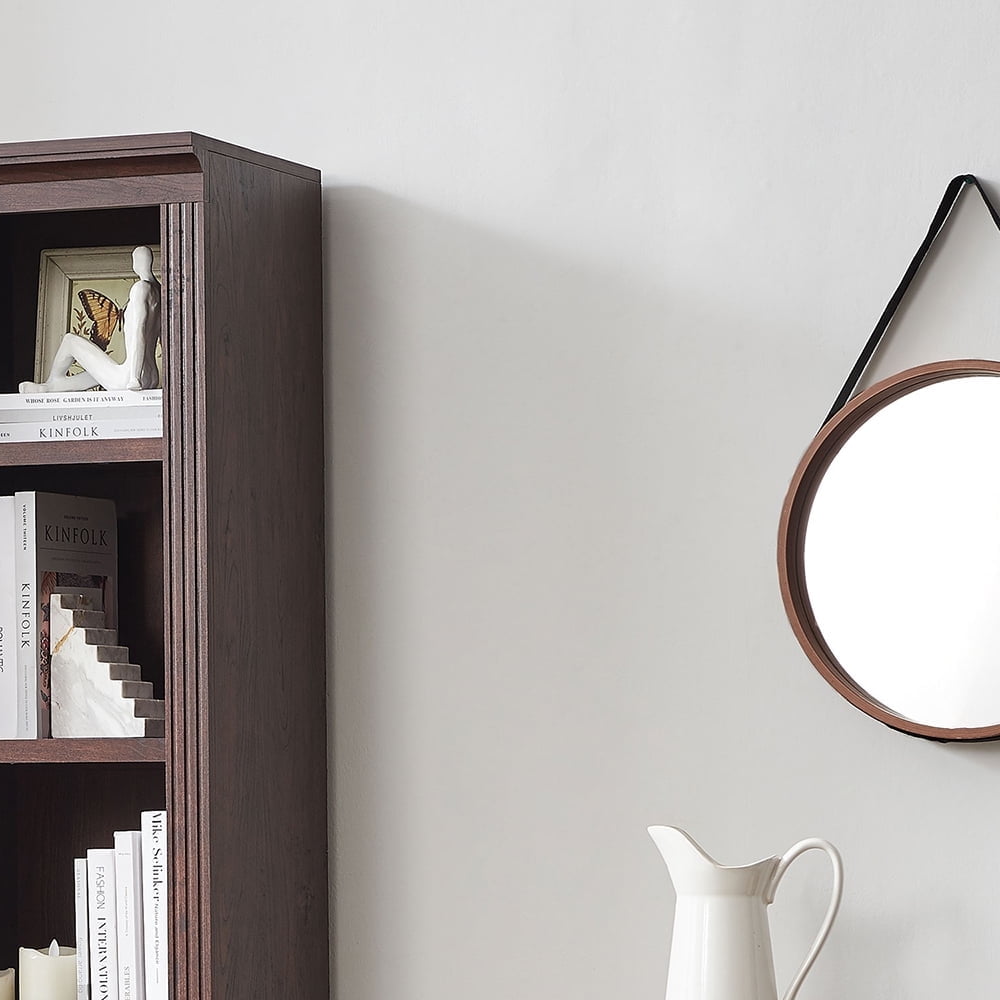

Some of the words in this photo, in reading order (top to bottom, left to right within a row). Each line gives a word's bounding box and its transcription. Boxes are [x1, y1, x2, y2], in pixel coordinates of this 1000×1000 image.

[39, 426, 99, 438] KINFOLK
[44, 524, 108, 546] KINFOLK
[21, 583, 31, 648] KINFOLK
[152, 813, 162, 843] Mike
[96, 866, 105, 910] FASHION
[152, 847, 163, 902] Selinker
